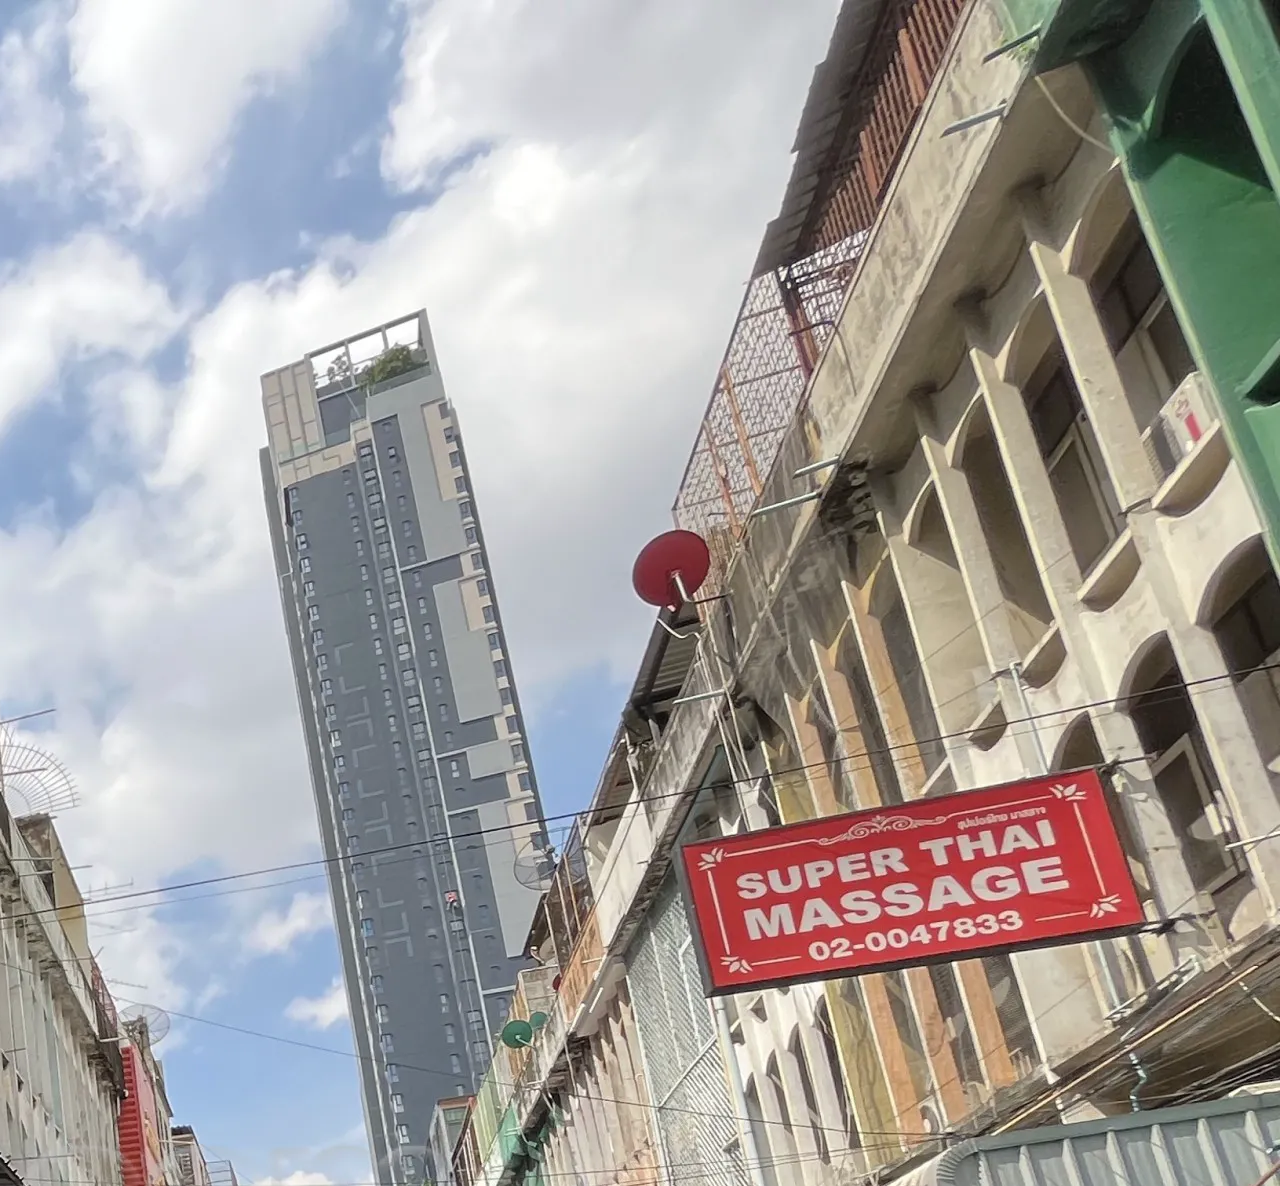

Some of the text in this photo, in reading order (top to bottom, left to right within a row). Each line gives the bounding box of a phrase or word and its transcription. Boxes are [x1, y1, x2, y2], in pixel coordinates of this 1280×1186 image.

[736, 820, 1057, 900] SUPER THAI
[742, 856, 1070, 941] MASSAGE
[809, 910, 1023, 962] 02-0047833
